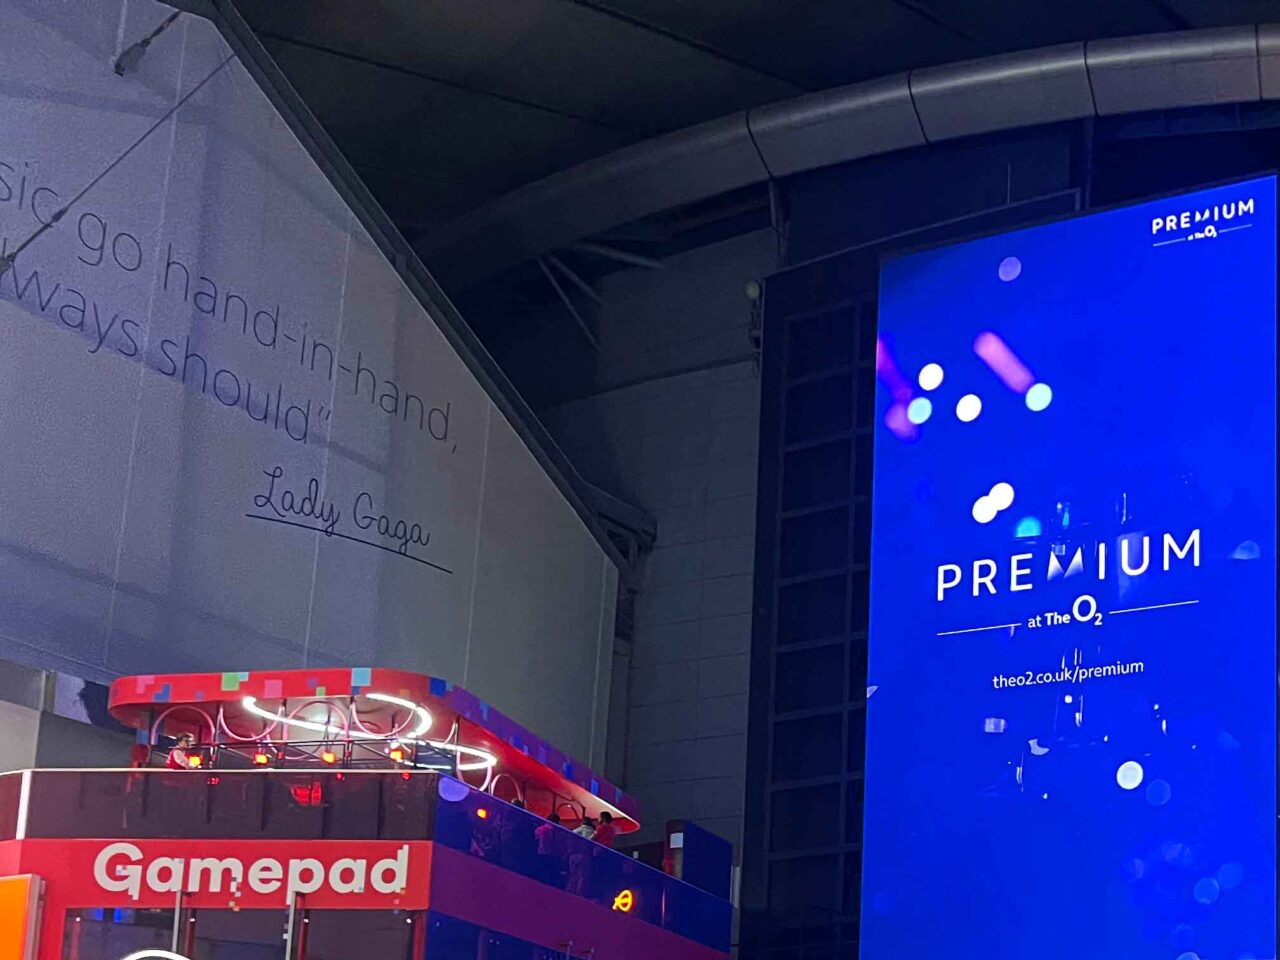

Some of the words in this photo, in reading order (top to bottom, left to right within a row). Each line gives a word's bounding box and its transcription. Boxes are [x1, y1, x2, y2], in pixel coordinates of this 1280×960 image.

[1151, 197, 1254, 235] PREMIUM
[77, 212, 142, 273] go
[163, 242, 458, 456] hand-in-hand,
[253, 466, 341, 537] Lady
[352, 492, 431, 550] Gaga
[936, 528, 1201, 602] PREMIUM
[1027, 614, 1042, 629] at
[1044, 611, 1071, 626] The
[1072, 594, 1103, 626] O2
[992, 660, 1144, 690] theo2.co.uk/premium
[93, 842, 409, 906] Gamepad
